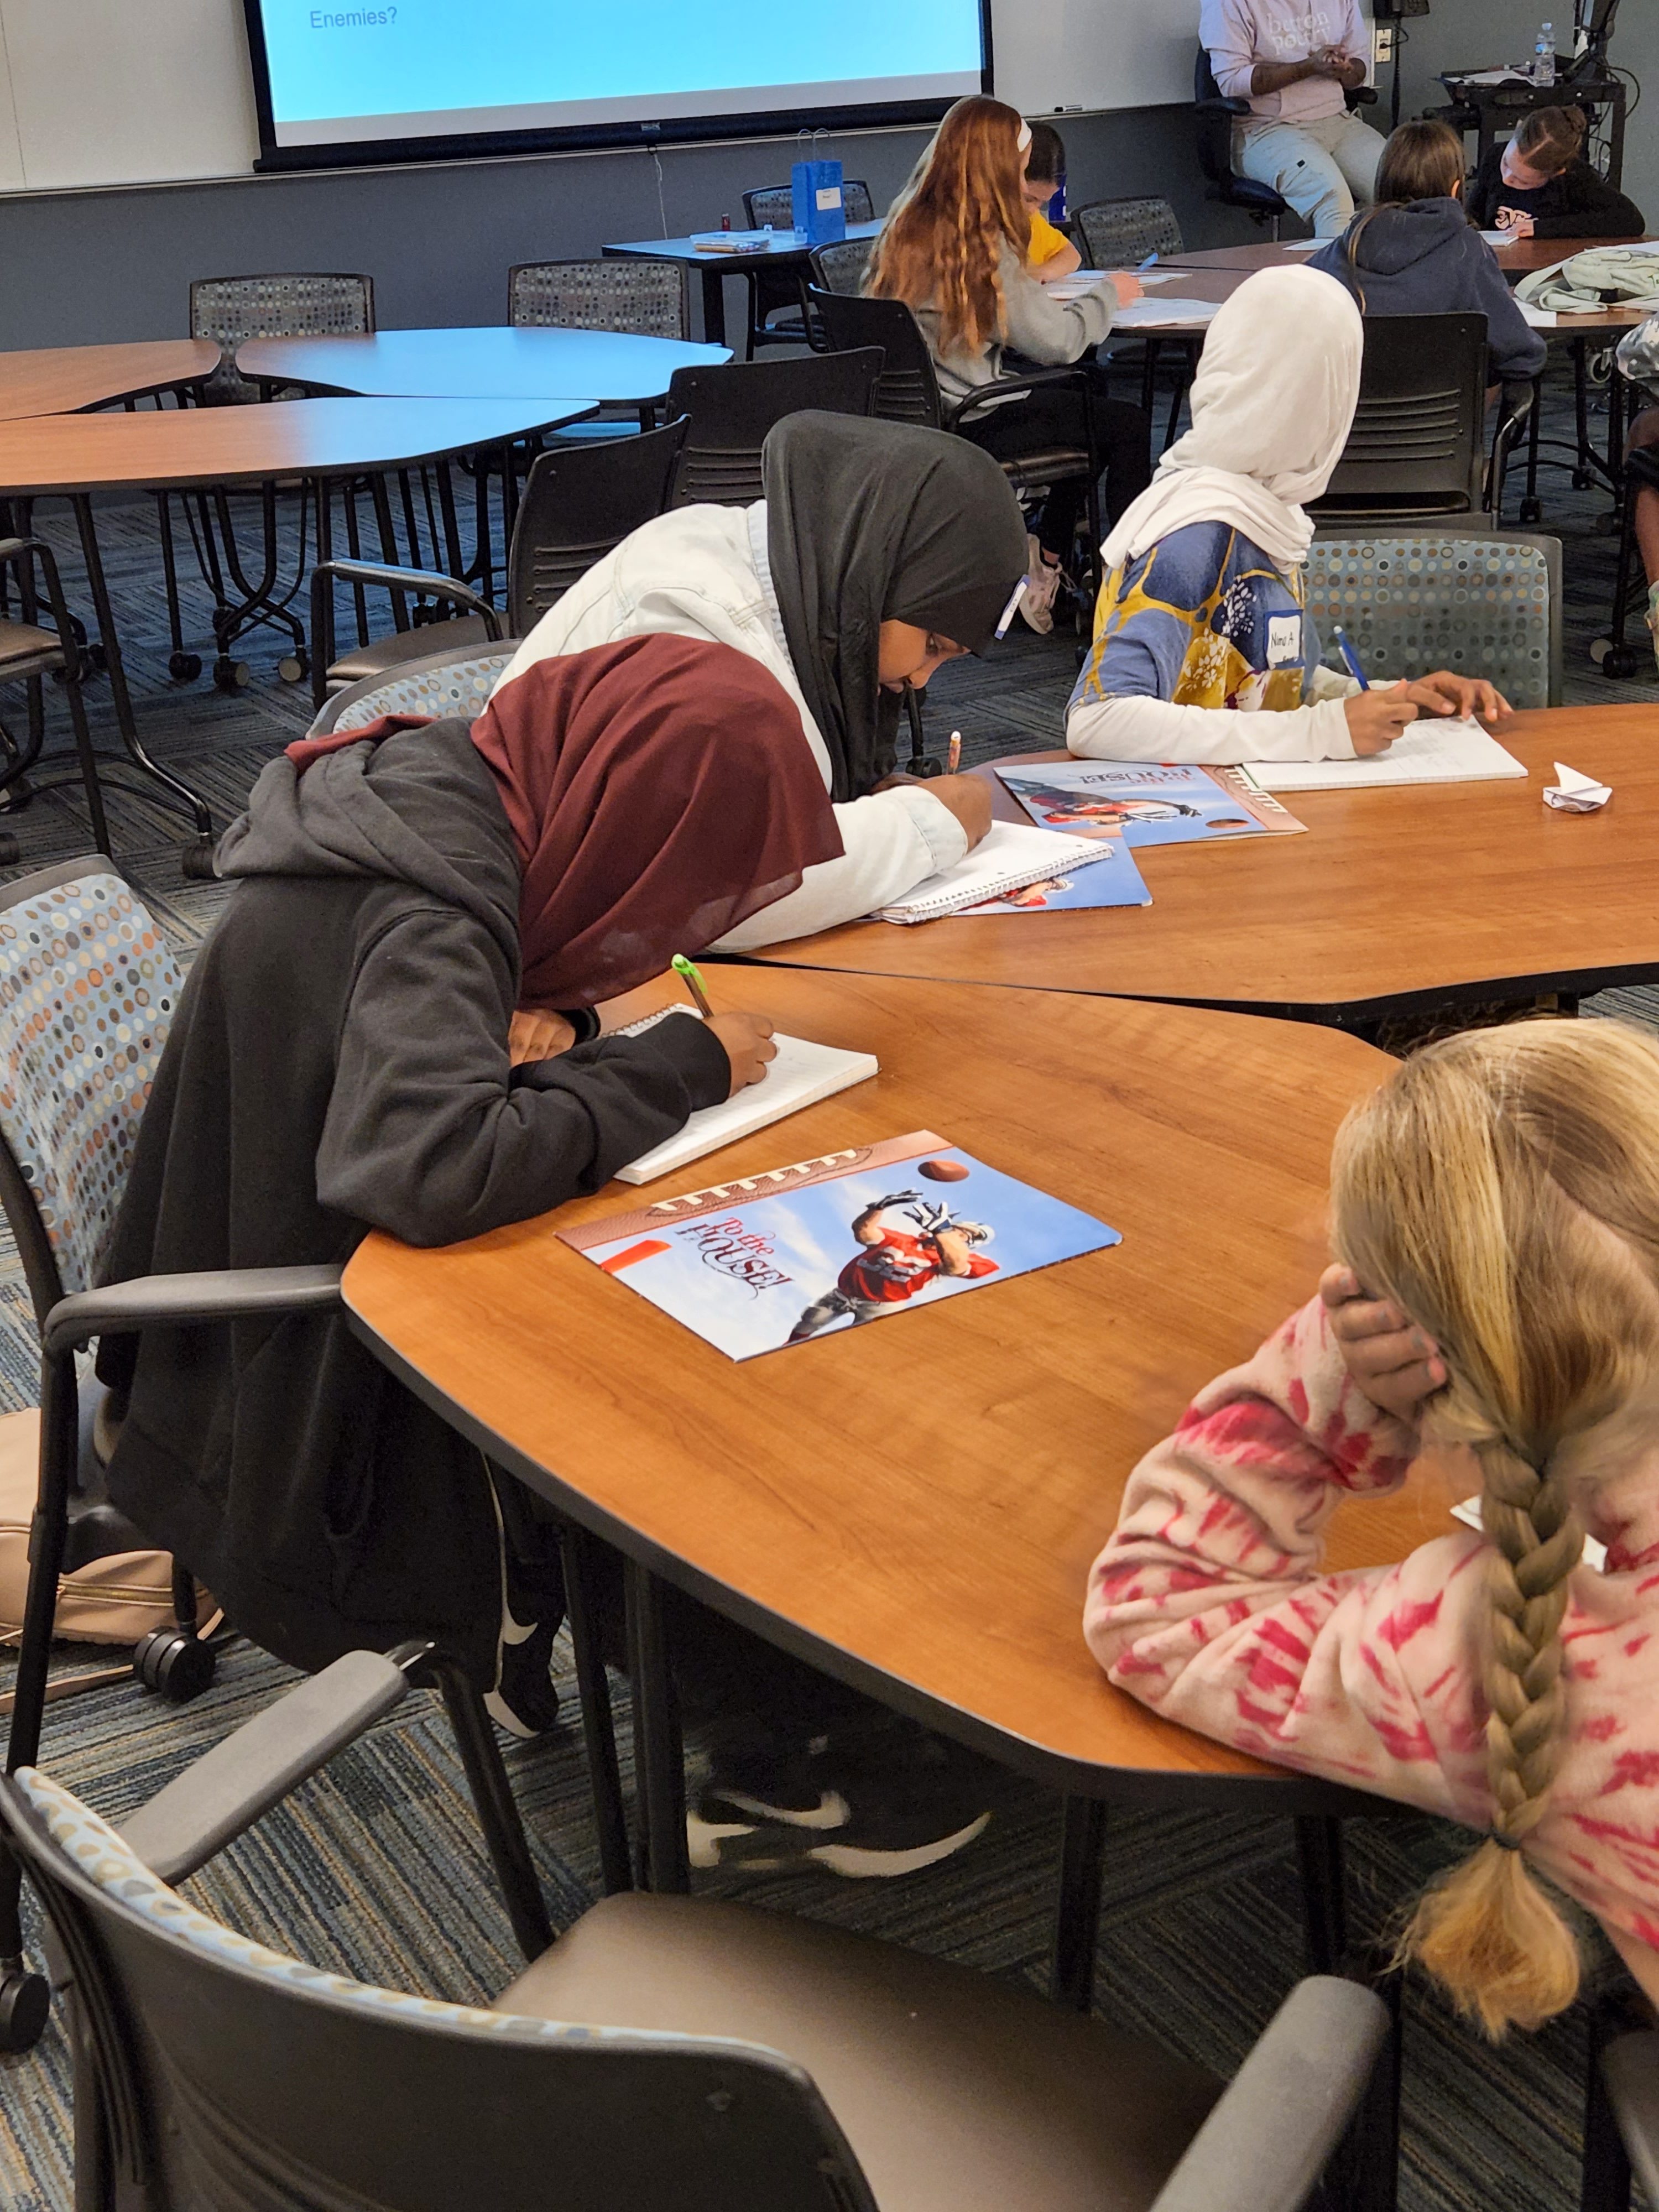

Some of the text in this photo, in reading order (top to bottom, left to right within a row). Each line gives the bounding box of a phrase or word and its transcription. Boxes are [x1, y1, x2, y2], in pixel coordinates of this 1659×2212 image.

[310, 6, 398, 28] Enemies?
[705, 1217, 776, 1256] To the
[674, 1223, 795, 1298] HOUSE!
